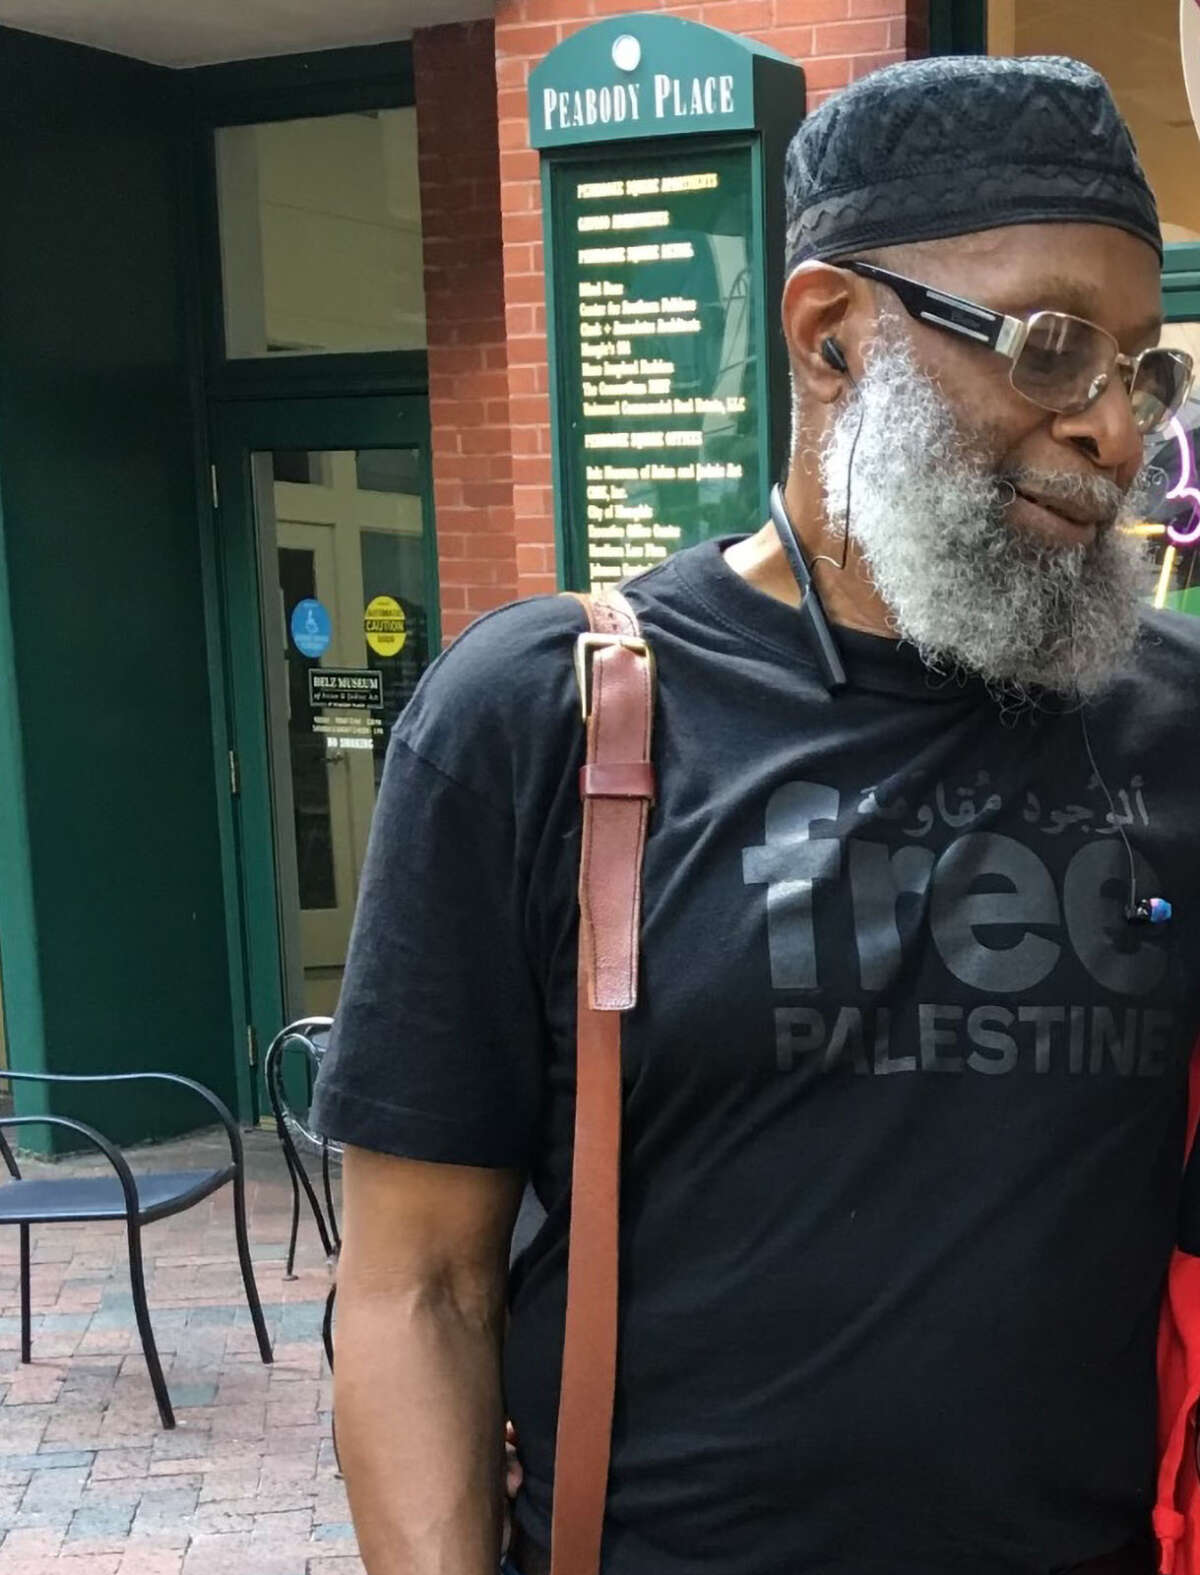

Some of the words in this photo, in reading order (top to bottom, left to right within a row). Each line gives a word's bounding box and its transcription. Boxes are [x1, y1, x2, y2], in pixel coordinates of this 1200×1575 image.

[543, 83, 640, 131] PEABODY
[654, 74, 734, 118] PLACE
[365, 619, 404, 632] CAUTION
[337, 677, 378, 689] MUSEUM
[742, 780, 1170, 995] free
[773, 1001, 1176, 1077] PALESTINE
